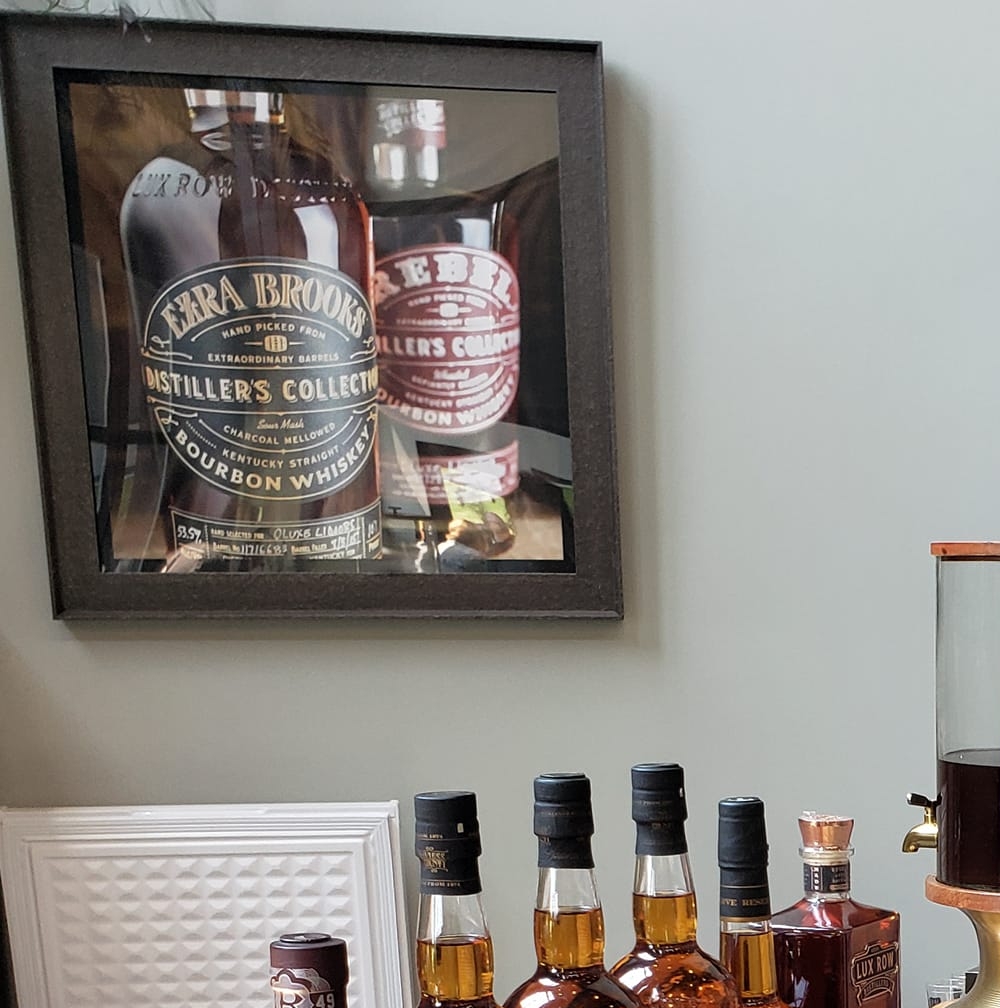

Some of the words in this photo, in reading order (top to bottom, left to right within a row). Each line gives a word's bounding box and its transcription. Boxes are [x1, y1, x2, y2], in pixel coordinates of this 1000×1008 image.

[160, 274, 248, 340] EZRA
[252, 272, 369, 338] BROOKS
[221, 324, 251, 340] HAND
[255, 322, 295, 333] PICKED
[300, 325, 327, 341] FROM
[207, 352, 294, 364] EXTRAORDINARY
[298, 352, 340, 364] BARRELS
[144, 365, 272, 404] DISTILLER'S
[282, 364, 379, 403] COLLECTIO
[223, 424, 280, 446] CHARCOAL
[284, 422, 337, 445] MELLOWED
[256, 419, 279, 430] Sour
[280, 417, 305, 430] Mash
[175, 428, 281, 491] BOURBON
[289, 424, 371, 490] WHISKEY
[222, 447, 284, 469] KENTUCKY
[288, 444, 340, 469] STRAIGHT
[856, 957, 875, 979] LUX
[876, 951, 894, 973] ROW
